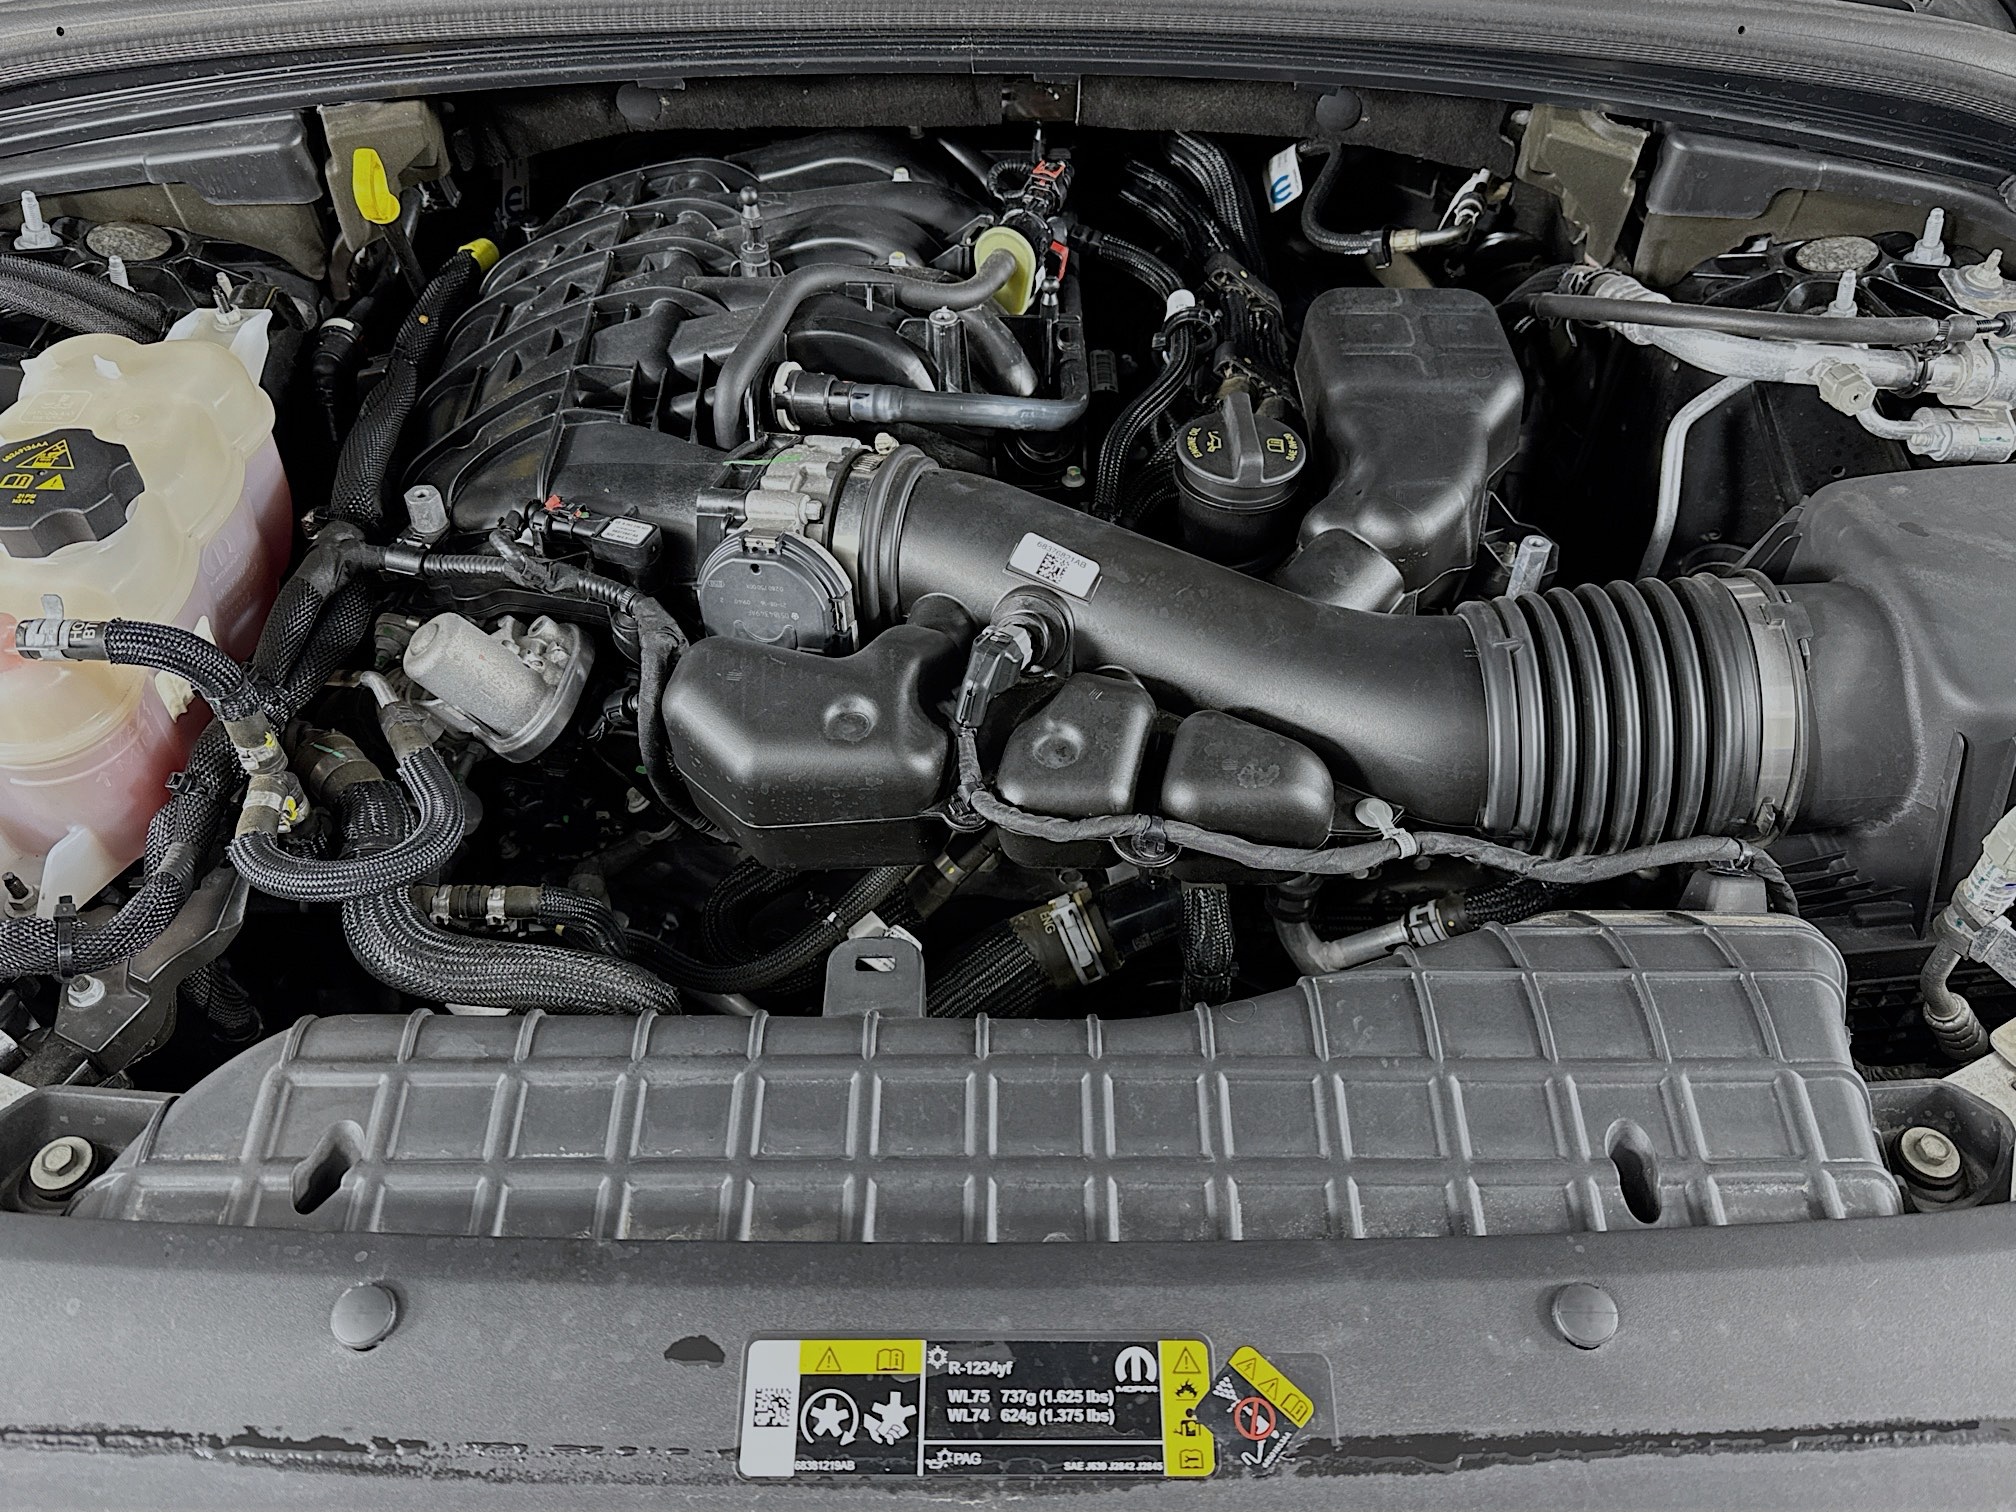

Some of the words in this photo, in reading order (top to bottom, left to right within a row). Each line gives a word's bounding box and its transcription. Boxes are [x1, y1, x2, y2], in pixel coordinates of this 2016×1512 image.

[1189, 427, 1202, 436] OIL
[1187, 435, 1204, 458] ENGINE
[1285, 449, 1298, 461] SAE
[1039, 910, 1057, 935] ENG
[948, 1360, 1014, 1378] R-1234yf
[947, 1389, 991, 1403] WL75
[1000, 1389, 1037, 1407] 737g
[1039, 1389, 1084, 1407] (1.625
[1085, 1389, 1115, 1407] lbs)
[947, 1408, 991, 1422] WL74
[1000, 1408, 1037, 1426] 624g
[1039, 1408, 1085, 1426] (1.375
[1086, 1408, 1115, 1426] lbs)
[953, 1452, 982, 1465] PAG
[1063, 1461, 1085, 1471] SAE
